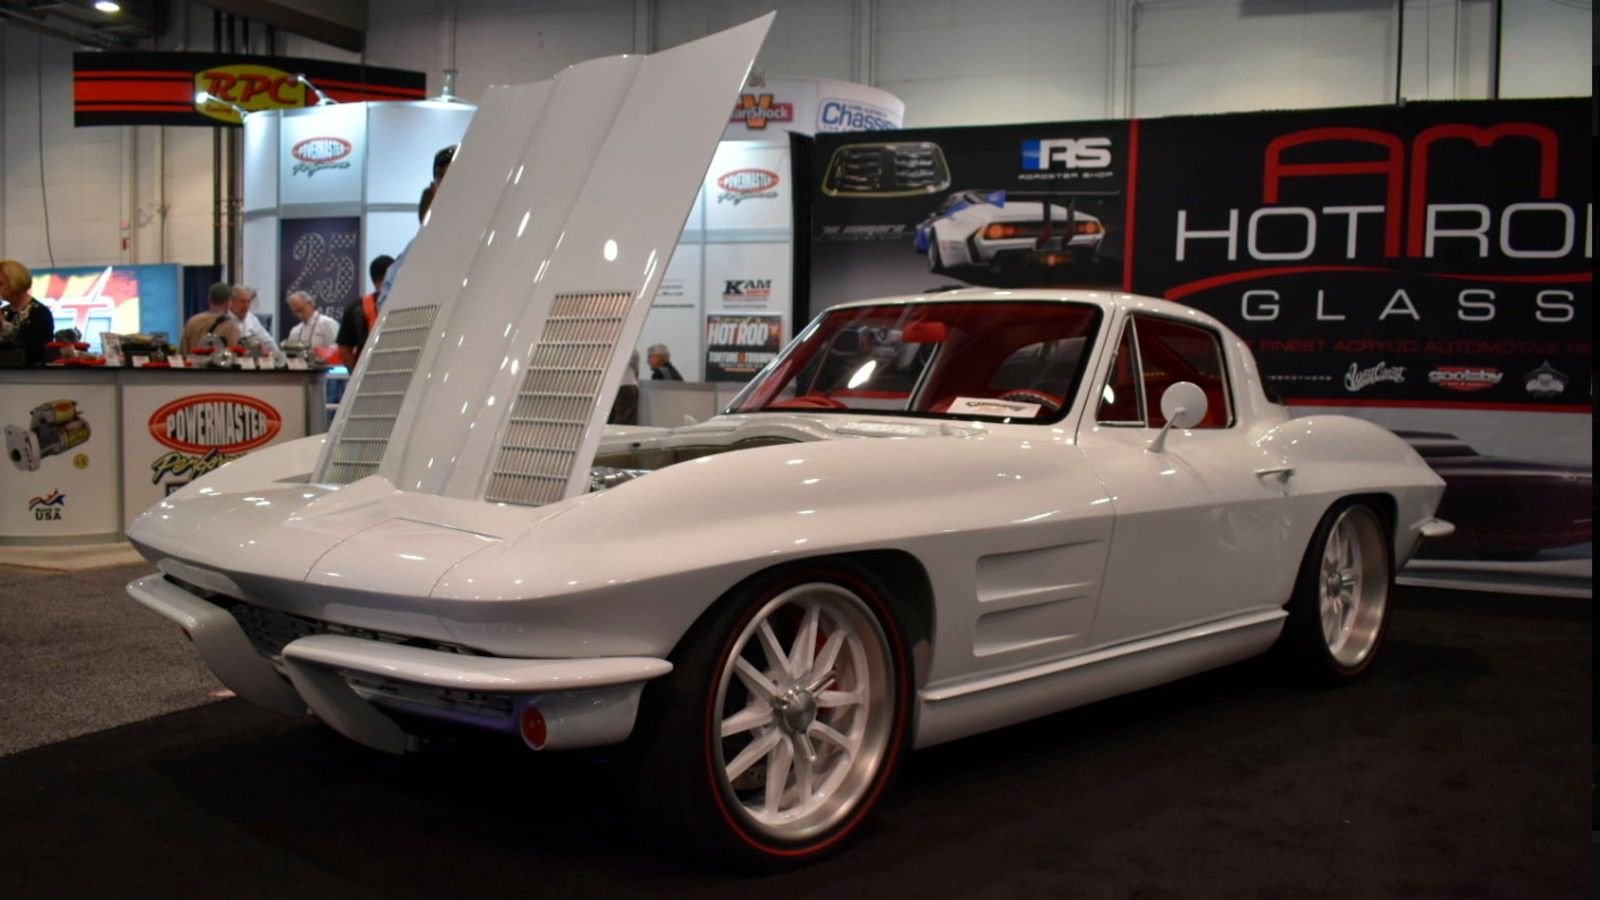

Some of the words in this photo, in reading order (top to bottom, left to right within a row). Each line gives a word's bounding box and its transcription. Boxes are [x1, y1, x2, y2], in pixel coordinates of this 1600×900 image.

[202, 71, 299, 105] RPC
[1176, 205, 1385, 261] HOT
[1424, 202, 1592, 260] RO
[288, 232, 356, 303] 25
[723, 280, 771, 295] KAM
[1241, 288, 1575, 323] GLASS
[707, 322, 738, 346] HOT
[736, 322, 769, 346] ROD
[1260, 339, 1327, 351] FINEST
[1334, 340, 1417, 352] ACRYLIC
[166, 401, 268, 446] POWERMASTER
[35, 511, 62, 521] USA
